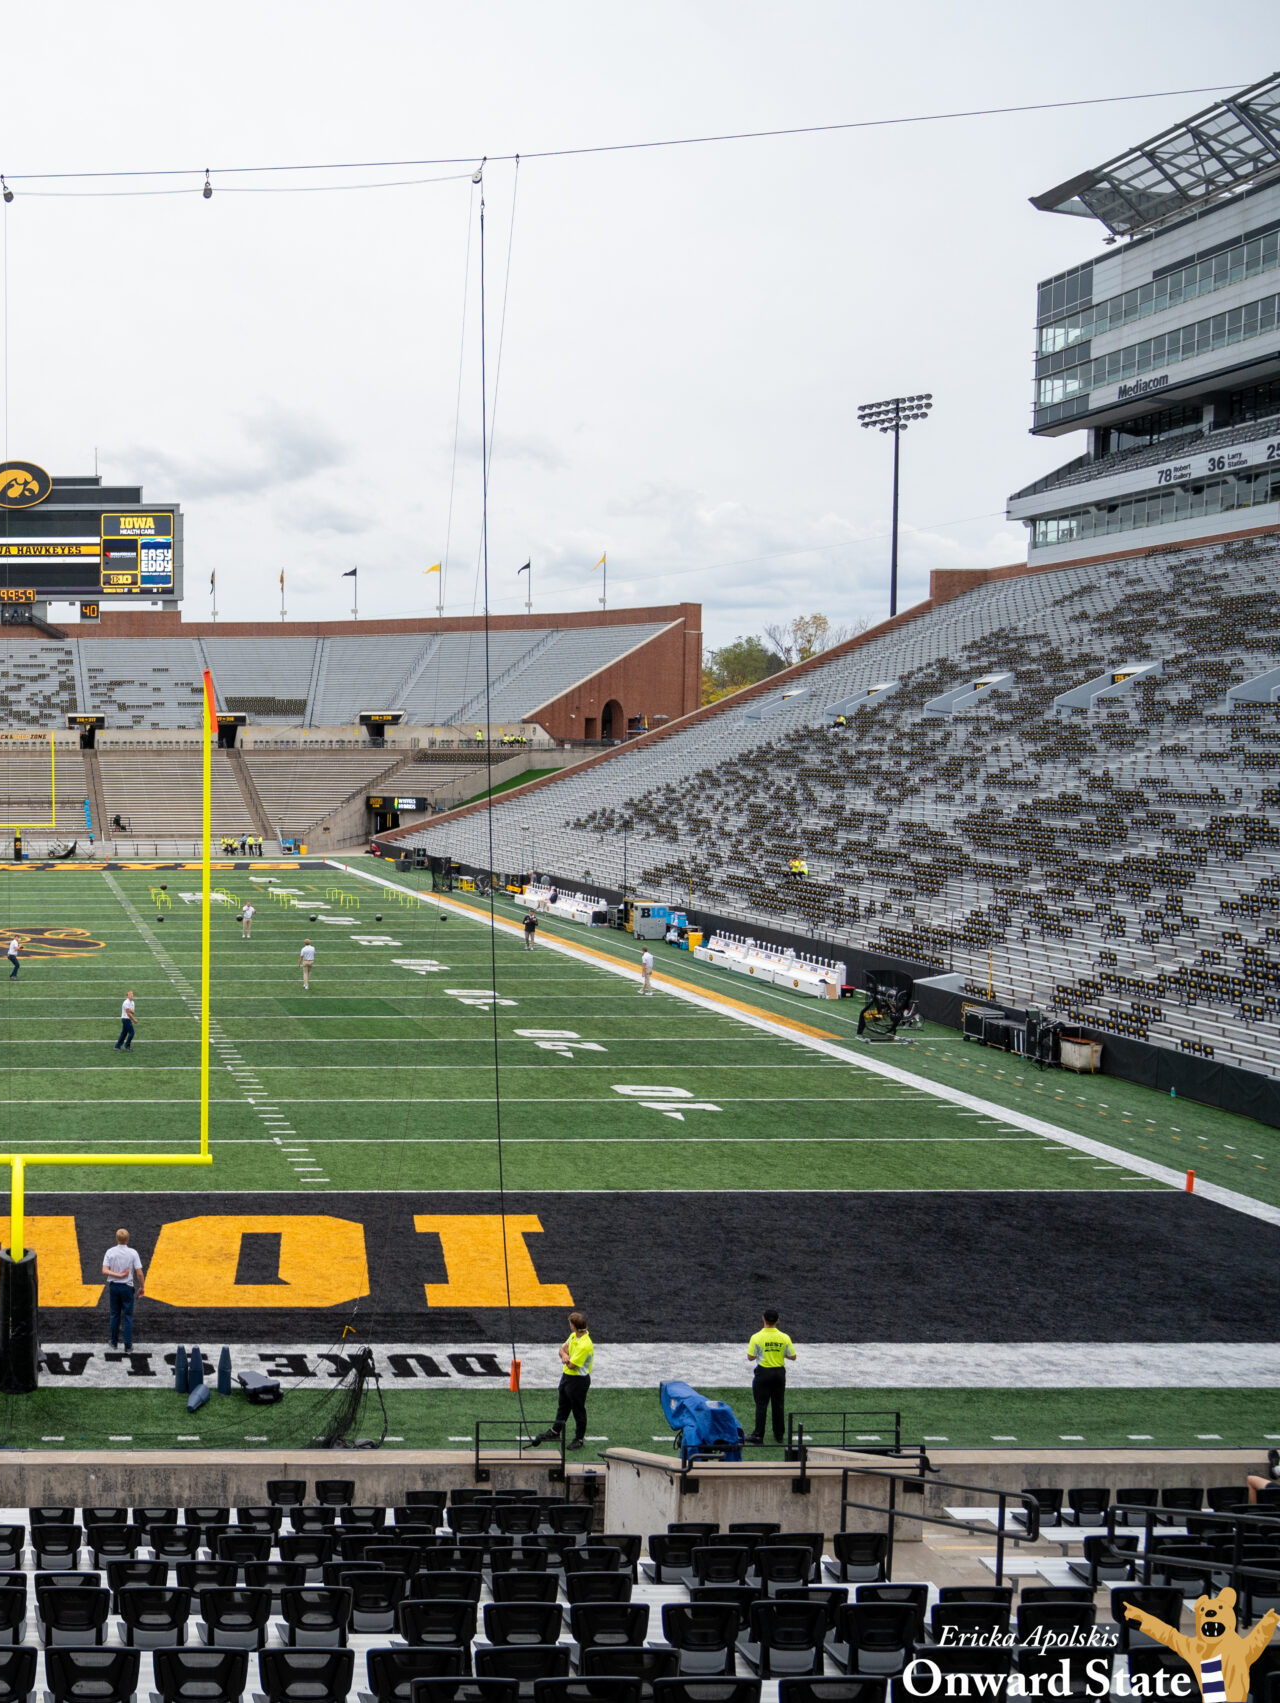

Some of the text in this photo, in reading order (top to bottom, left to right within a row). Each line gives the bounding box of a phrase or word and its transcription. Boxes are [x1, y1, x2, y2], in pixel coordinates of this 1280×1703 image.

[1118, 374, 1169, 399] Mediacom
[1227, 452, 1242, 460] Larry
[1173, 463, 1191, 473] Robert
[1208, 455, 1225, 472] 36
[1227, 459, 1248, 468] Station
[1157, 468, 1172, 484] 78
[1173, 472, 1192, 481] Gallery
[120, 517, 155, 529] IOWA
[17, 546, 82, 554] HAWKEYES
[141, 549, 171, 560] EASY
[141, 561, 171, 571] EDDY
[0, 590, 34, 601] 99:59
[82, 605, 98, 617] 40
[350, 935, 403, 946] 50
[391, 959, 450, 973] 40
[443, 989, 518, 1006] 30
[513, 1029, 608, 1051] 20
[611, 1085, 723, 1113] 10
[259, 1353, 510, 1378] DUKE
